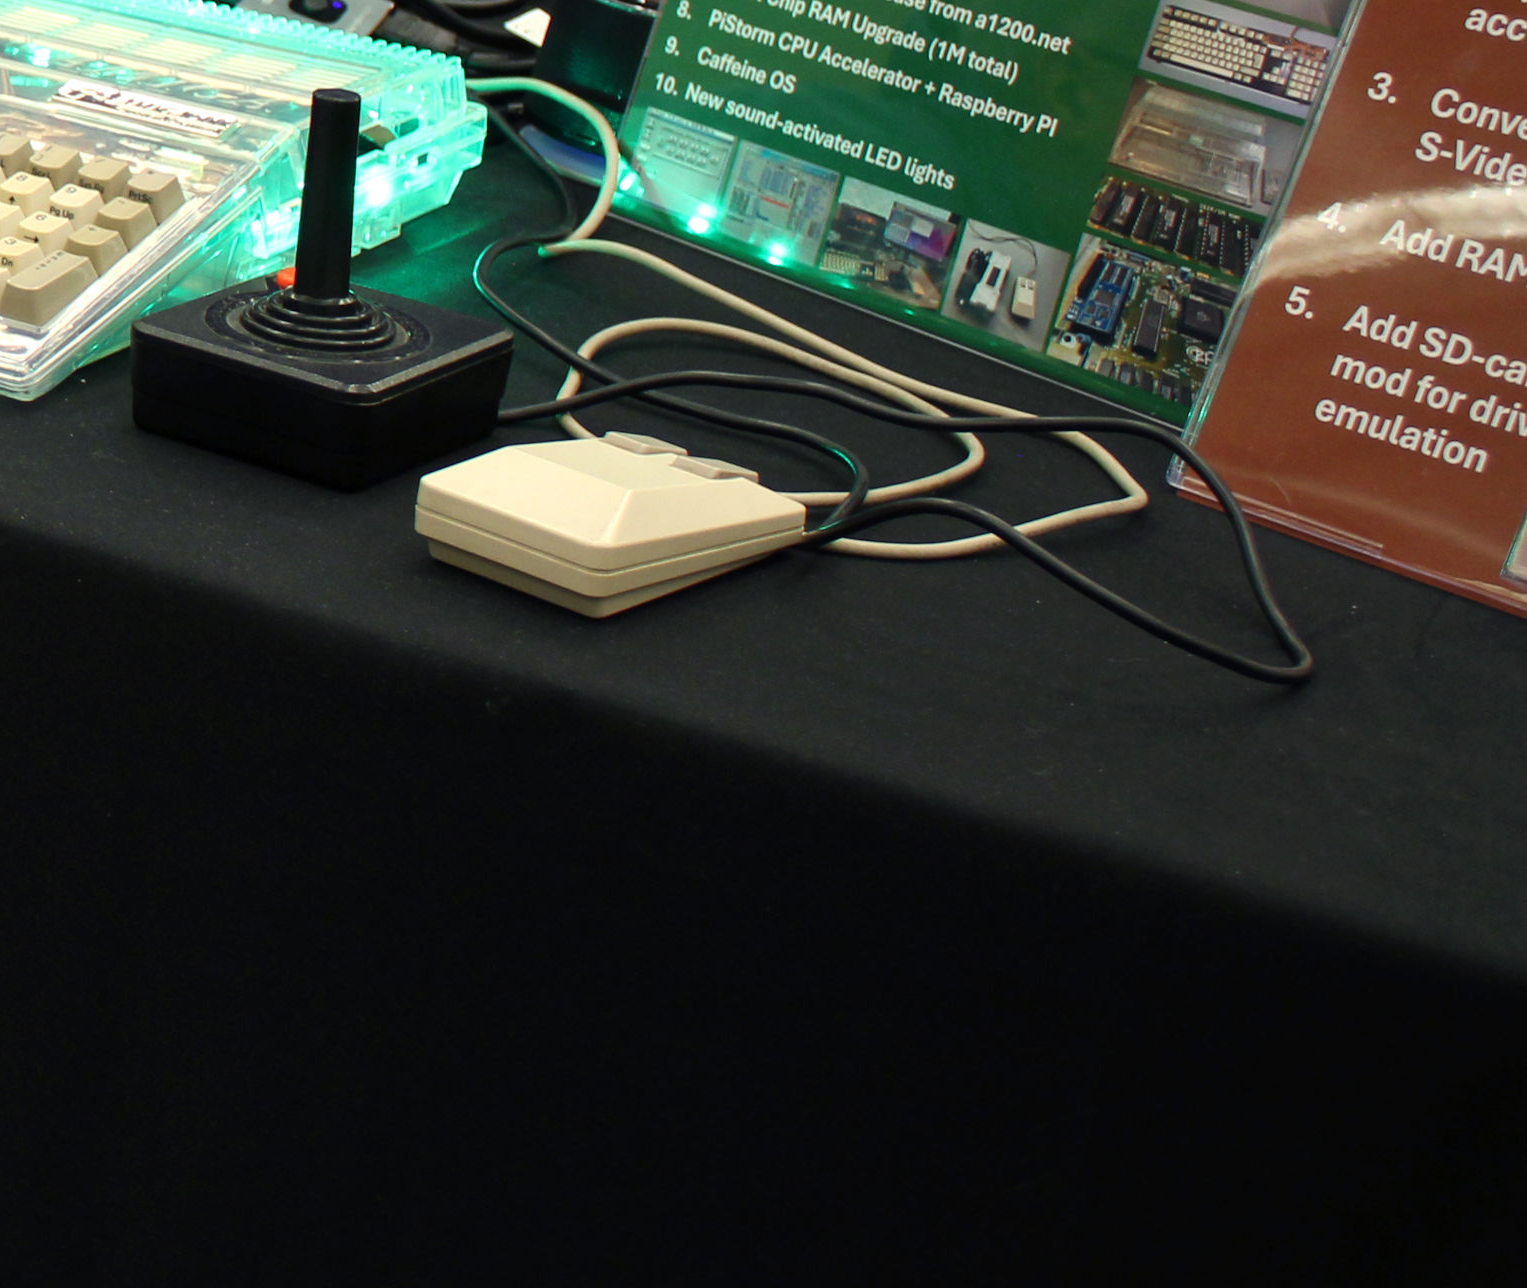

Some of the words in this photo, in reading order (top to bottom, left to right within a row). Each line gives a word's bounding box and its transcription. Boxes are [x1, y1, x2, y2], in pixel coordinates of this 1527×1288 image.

[665, 36, 680, 56] 9.
[697, 46, 767, 85] Caffeine
[770, 70, 797, 94] OS
[677, 0, 692, 20] 8.
[708, 9, 776, 47] PiStorm
[778, 32, 819, 59] CPU
[818, 45, 922, 93] Accelerator
[938, 83, 1035, 133] Raspberry
[808, 0, 852, 29] RAM
[852, 13, 926, 53] Upgrade
[928, 38, 967, 65] (1M
[968, 51, 1019, 85] total)
[974, 13, 1072, 55] a1200.net
[1367, 71, 1397, 104] 3.
[656, 73, 678, 96] 10.
[685, 82, 725, 110] New
[725, 100, 865, 159] sound-activated
[865, 143, 903, 171] LED
[904, 157, 955, 190] lights
[1317, 201, 1347, 233] 4.
[1379, 218, 1455, 263] Add
[1285, 286, 1314, 319] 5.
[1342, 305, 1418, 350] Add
[1419, 326, 1527, 387] SD-ca
[1330, 353, 1412, 398] mod
[1414, 374, 1467, 414] for
[1315, 398, 1489, 473] emulation
